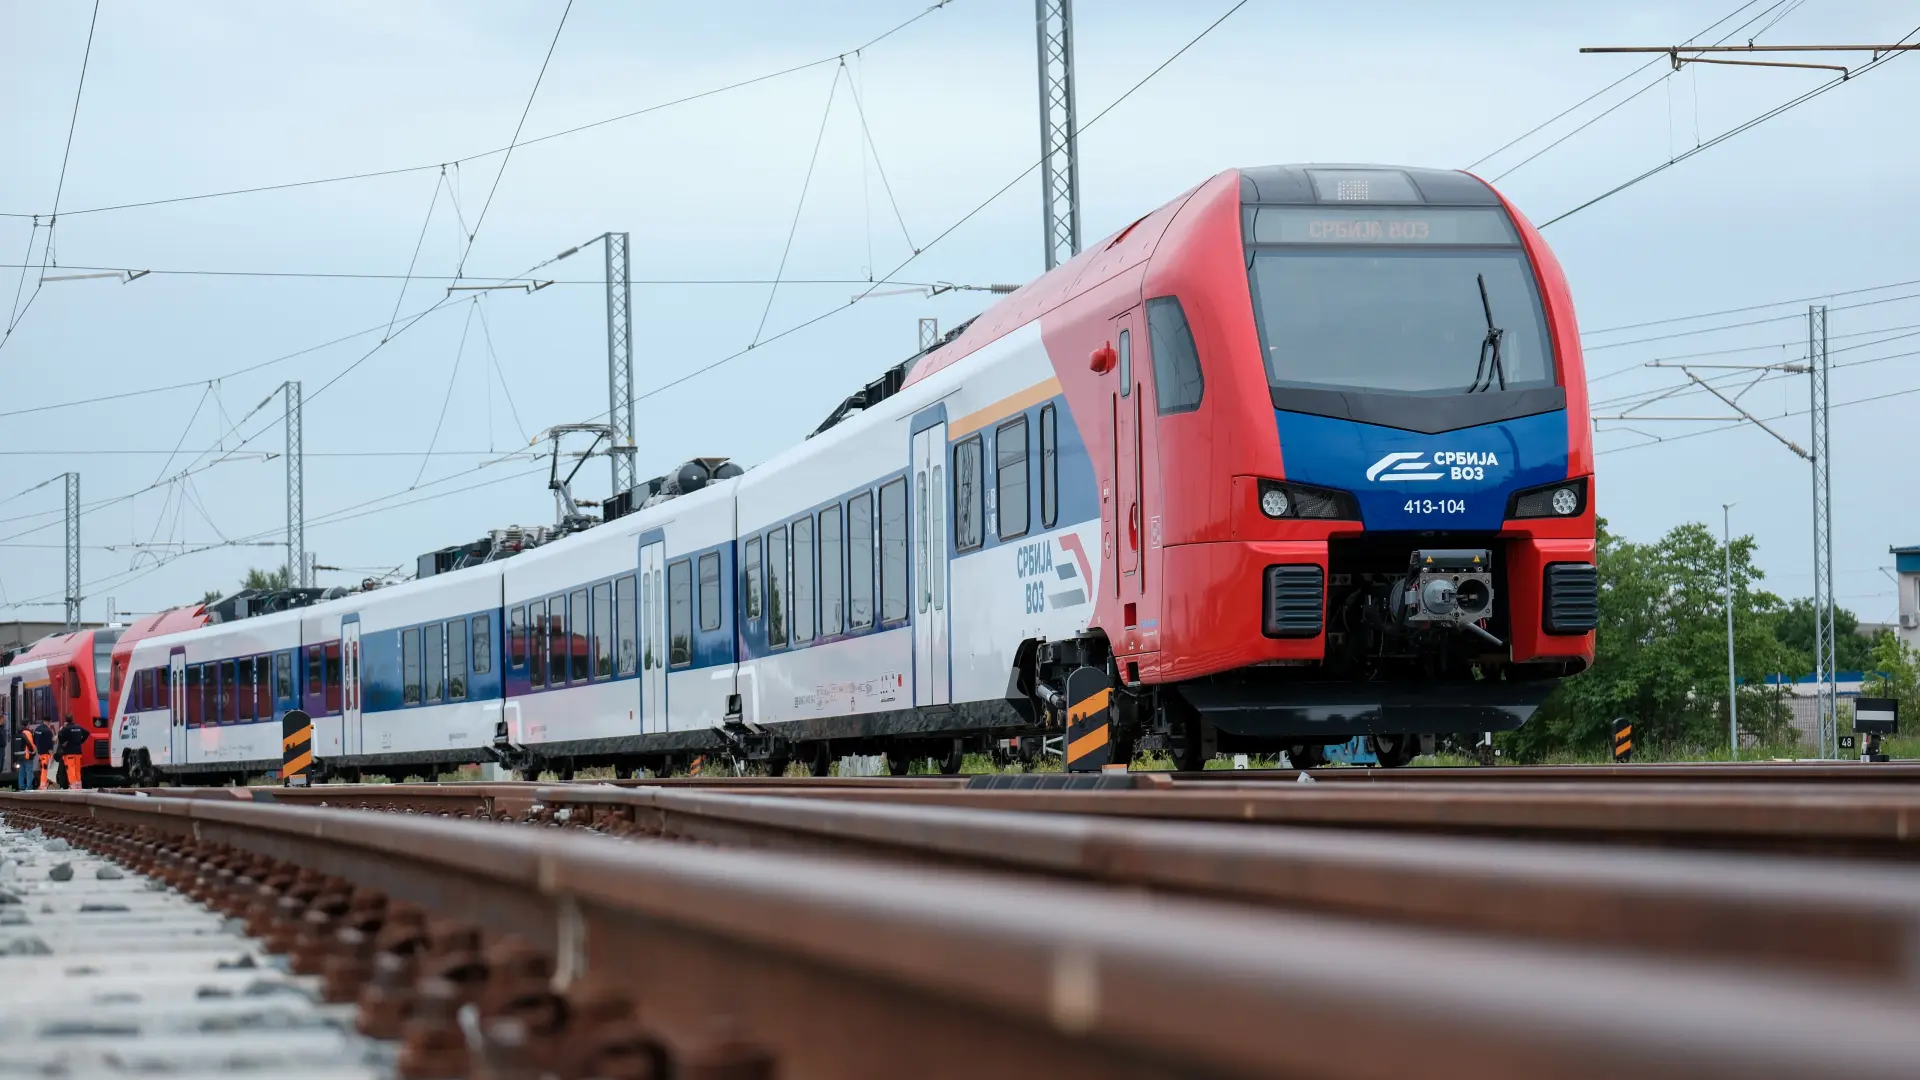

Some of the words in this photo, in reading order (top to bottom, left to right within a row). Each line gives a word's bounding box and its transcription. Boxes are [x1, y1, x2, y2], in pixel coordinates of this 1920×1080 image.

[1309, 221, 1383, 238] СРБИЈА
[1389, 222, 1428, 238] ВОЗ
[1434, 452, 1498, 465] СРБИЈА
[1451, 467, 1484, 480] ВОЗ
[1404, 500, 1465, 514] 413-104
[1017, 540, 1052, 578] СРБИЈА
[1026, 580, 1044, 614] ВОЗ
[1842, 738, 1851, 747] 48
